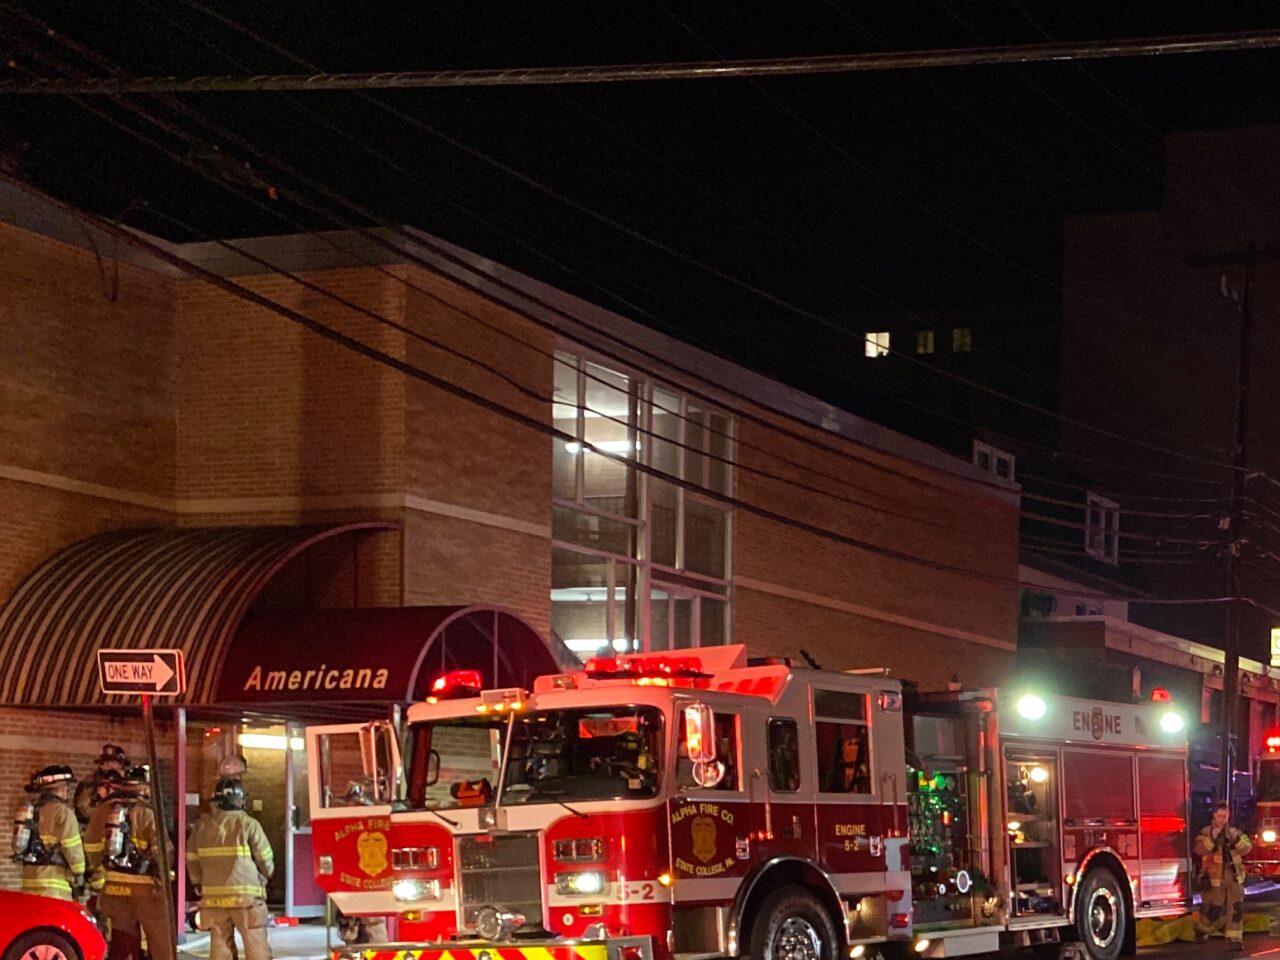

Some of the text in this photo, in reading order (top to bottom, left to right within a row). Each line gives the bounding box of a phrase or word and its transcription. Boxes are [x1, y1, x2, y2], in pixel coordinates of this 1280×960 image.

[108, 663, 154, 680] ONE WAY
[243, 664, 389, 691] Americana
[671, 804, 698, 825] ALPHA
[700, 803, 719, 816] FIRE
[835, 824, 866, 836] ENGINE
[675, 857, 694, 875] STATE
